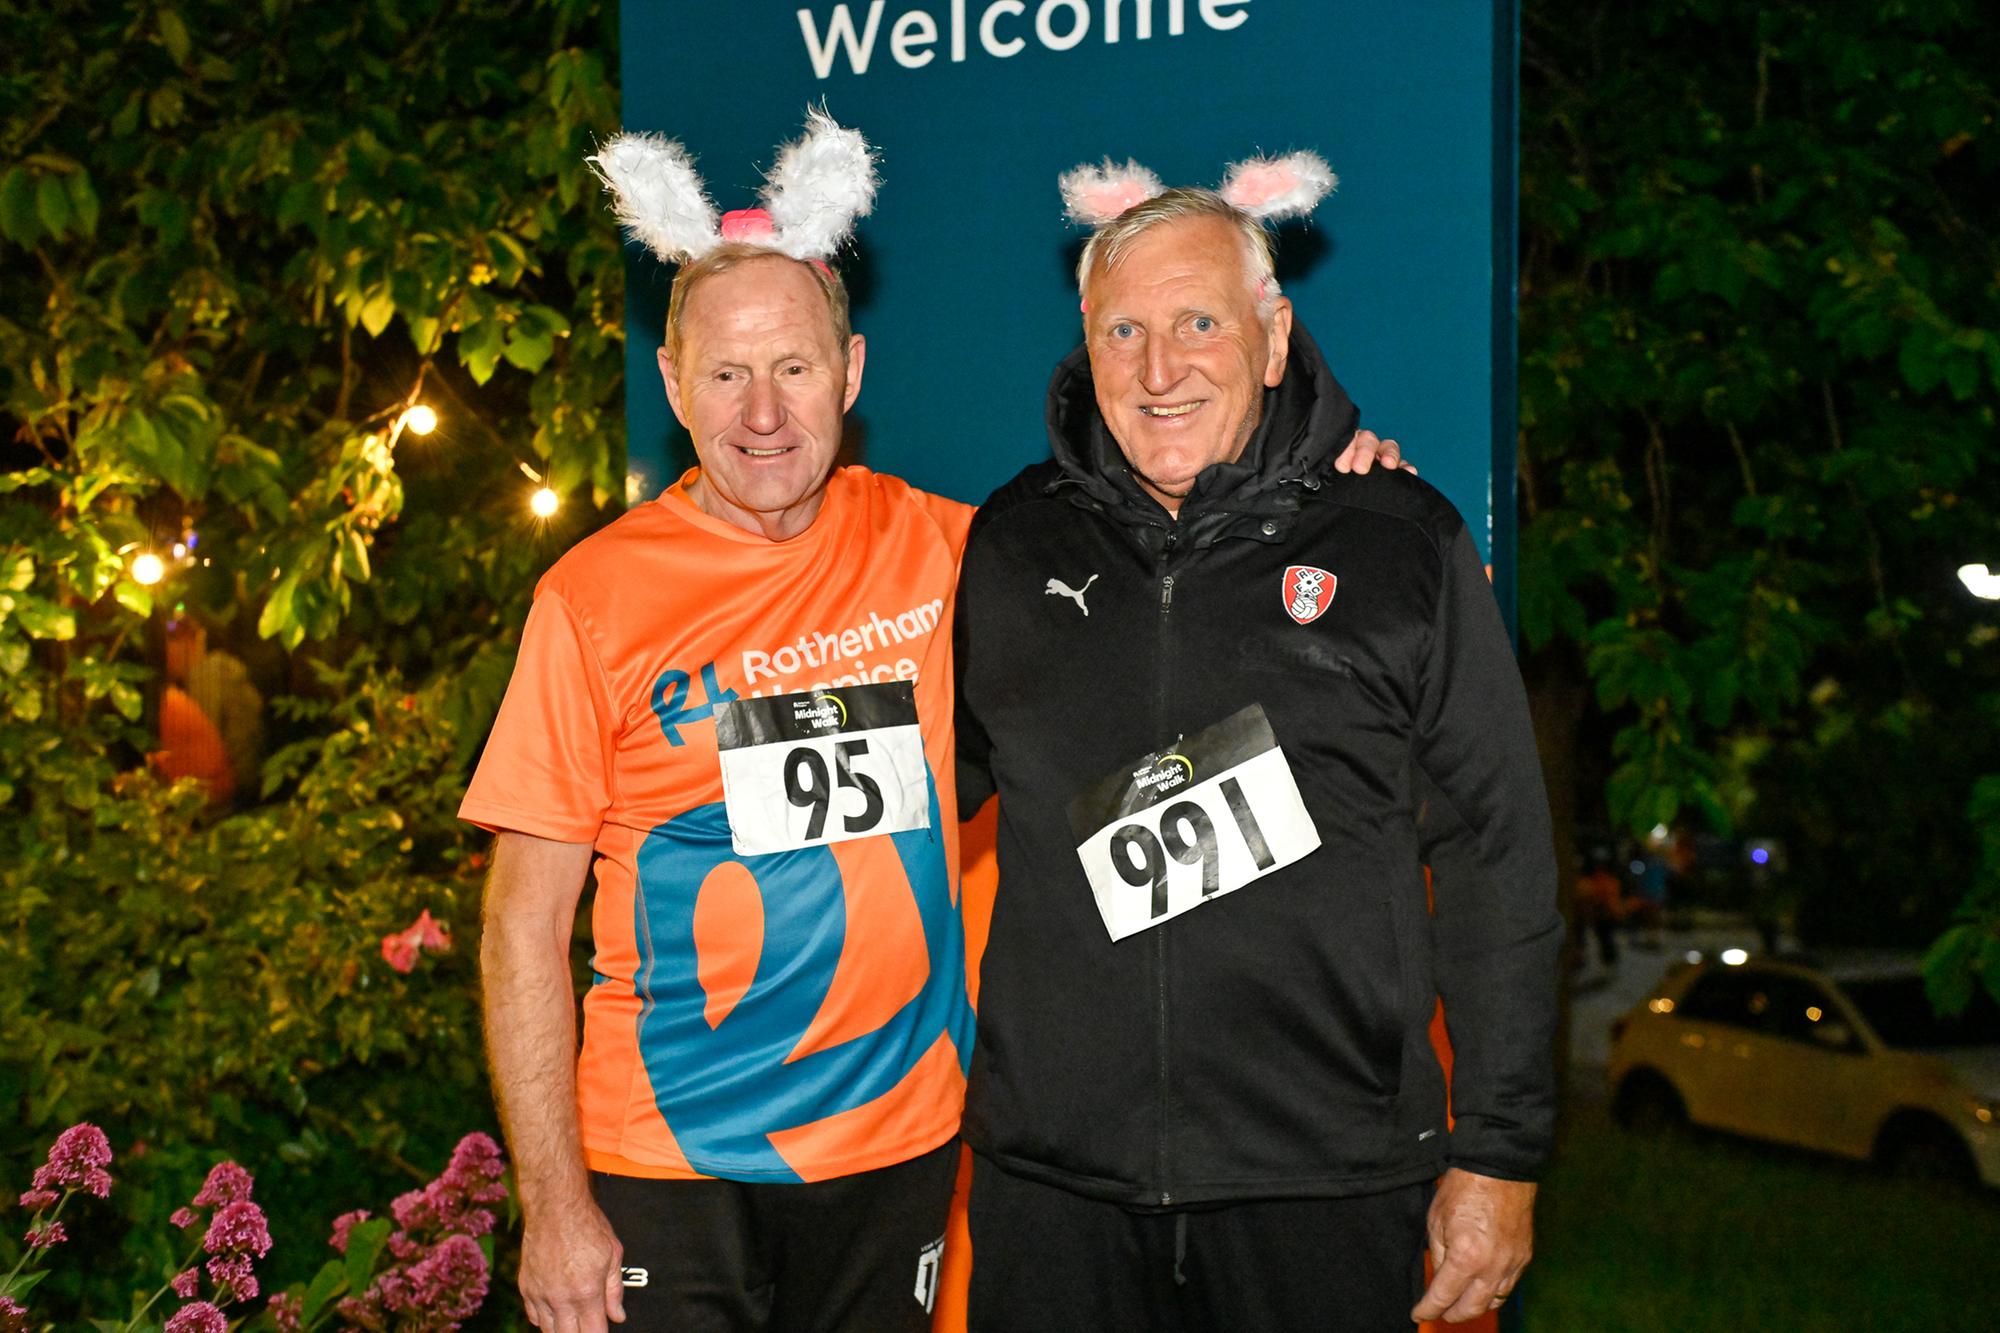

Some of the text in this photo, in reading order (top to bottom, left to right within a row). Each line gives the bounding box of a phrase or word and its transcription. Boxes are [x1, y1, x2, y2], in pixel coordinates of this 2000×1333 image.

[742, 599, 944, 685] Rotherham
[794, 705, 839, 720] Midnight
[811, 715, 839, 729] Walk
[783, 738, 884, 840] 95
[1136, 763, 1184, 789] Midnight
[1157, 774, 1186, 792] Walk
[1109, 776, 1277, 919] 991
